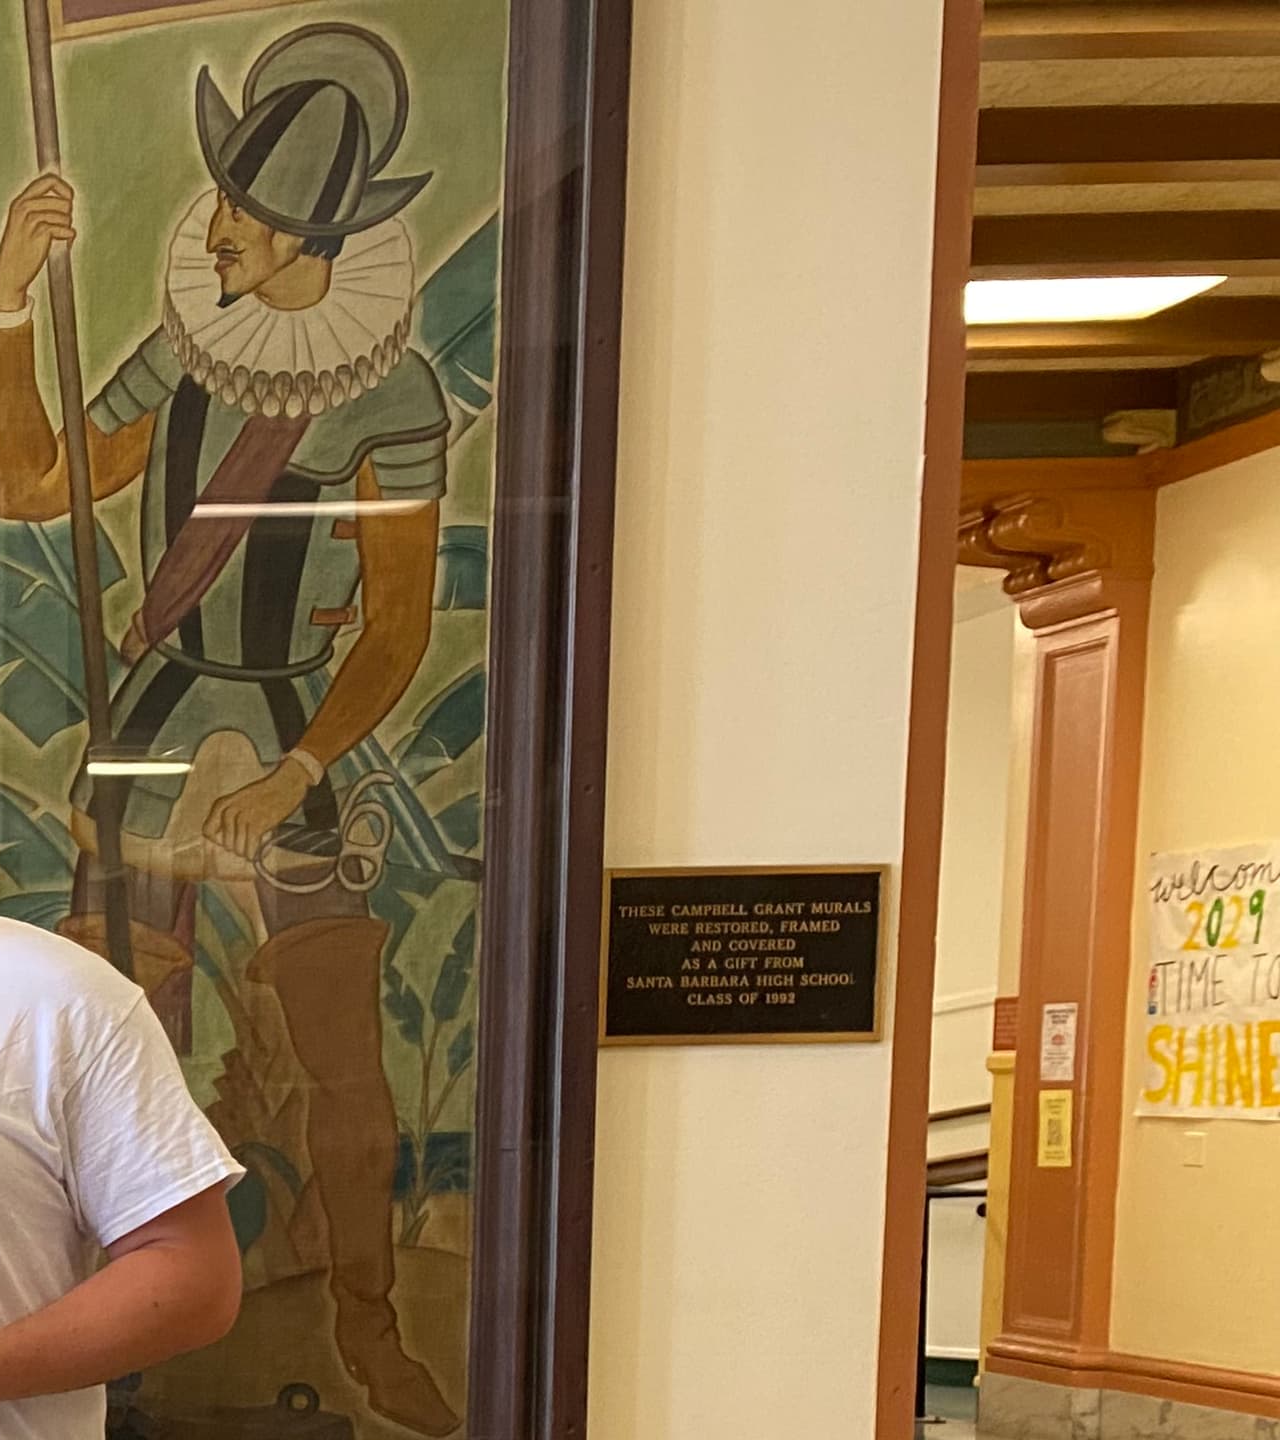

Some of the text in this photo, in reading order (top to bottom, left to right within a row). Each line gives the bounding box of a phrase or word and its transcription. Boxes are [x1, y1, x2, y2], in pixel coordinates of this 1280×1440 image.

[1150, 860, 1280, 903] welcom
[618, 901, 872, 918] THESE CAMPBELL GRANT MURALS
[648, 920, 840, 935] WERE RESTORED, FRAMED
[1181, 888, 1267, 952] 2029
[691, 938, 796, 952] AND COVERED
[681, 956, 804, 970] AS A GIFT FROM
[626, 973, 856, 989] SANTA BARBARA HIGH SCHOOL
[1154, 954, 1228, 1016] TIME
[687, 993, 733, 1005] CLASS
[738, 992, 759, 1005] OF
[1143, 1020, 1280, 1109] SHINE
